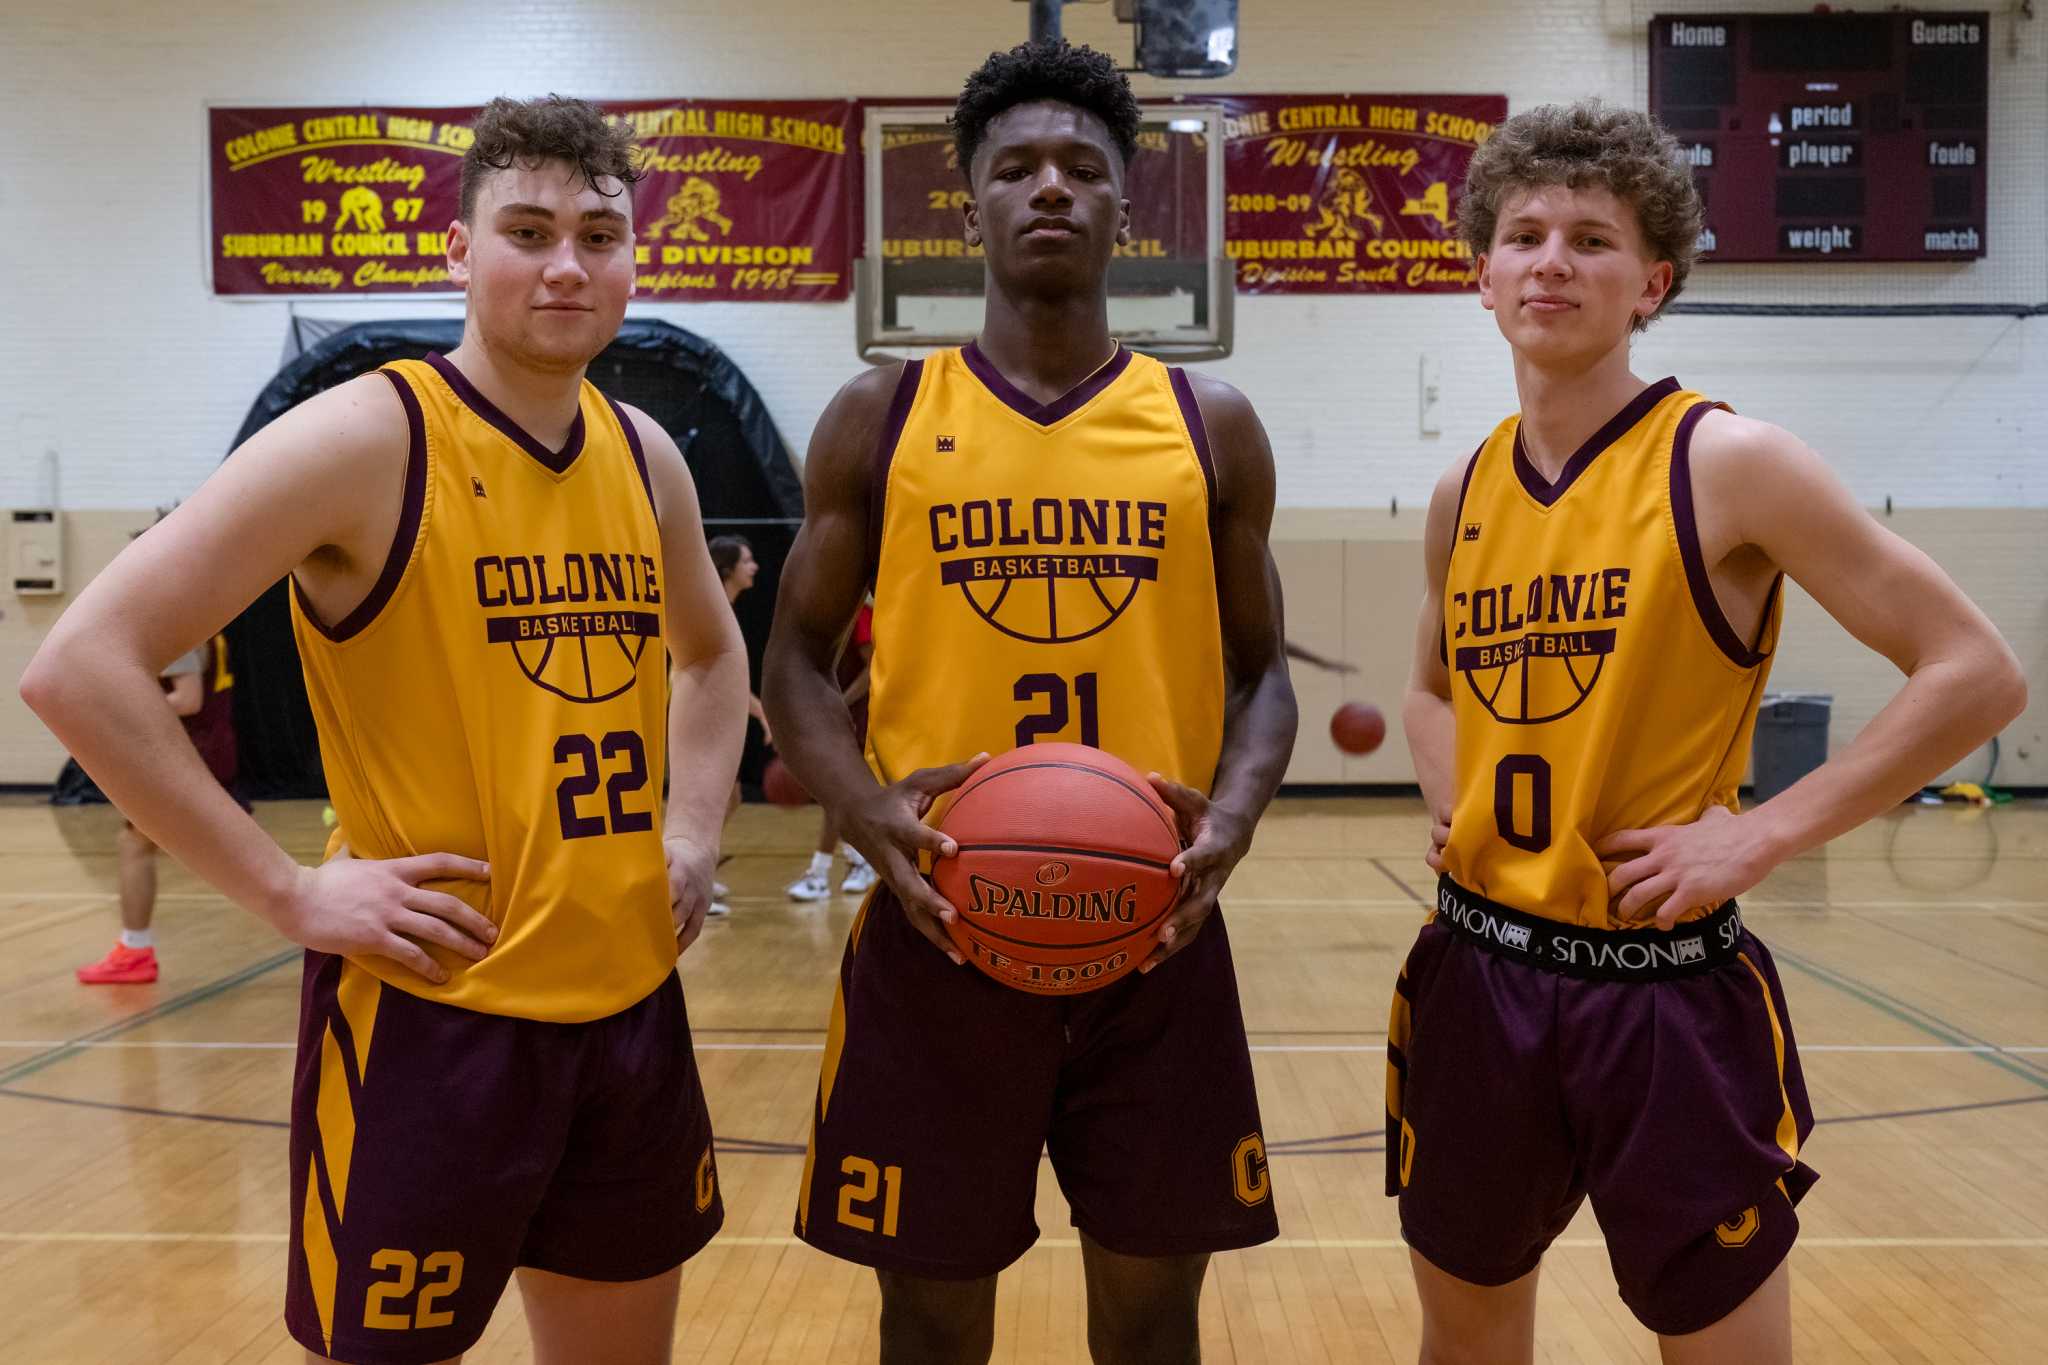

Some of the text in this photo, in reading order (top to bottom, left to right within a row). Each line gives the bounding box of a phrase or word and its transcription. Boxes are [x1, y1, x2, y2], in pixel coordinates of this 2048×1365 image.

[1671, 22, 1726, 46] Home
[1912, 20, 1980, 44] Guests
[1278, 106, 1361, 130] CENTRAL
[1369, 107, 1418, 131] HIGH
[1791, 101, 1852, 130] period
[225, 114, 476, 162] COLONIE CENTRAL HIGH SCH
[714, 110, 764, 137] HIGH
[770, 115, 846, 152] SCHOOL
[1264, 138, 1420, 177] Wrestling
[1788, 139, 1853, 167] player
[1928, 141, 1976, 166] fouls
[300, 156, 426, 191] Wrestling
[301, 200, 327, 223] 19
[392, 198, 425, 222] 97
[1226, 194, 1313, 214] 2008-09
[222, 233, 324, 257] SUBURBAN
[331, 232, 410, 256] COUNCIL
[1225, 239, 1356, 259] UBURBAN
[1787, 224, 1852, 252] weight
[1924, 227, 1980, 250] match
[661, 246, 814, 265] DIVISION
[730, 266, 796, 290] 1998
[1240, 260, 1478, 289] Division South Champ
[929, 498, 1167, 553] COLONIE
[474, 552, 660, 608] COLONIE
[973, 556, 1127, 578] BASKETBALL
[519, 613, 637, 638] BASKETBAL
[1013, 671, 1100, 750] 21
[552, 729, 653, 840] 22
[1493, 754, 1552, 854] 0
[967, 872, 1138, 924] SPALDING
[1440, 887, 1509, 944] NOVUS
[1551, 935, 1679, 969] NOVUS
[1231, 1130, 1269, 1208] C
[837, 1154, 902, 1238] 21
[362, 1247, 465, 1331] 22
